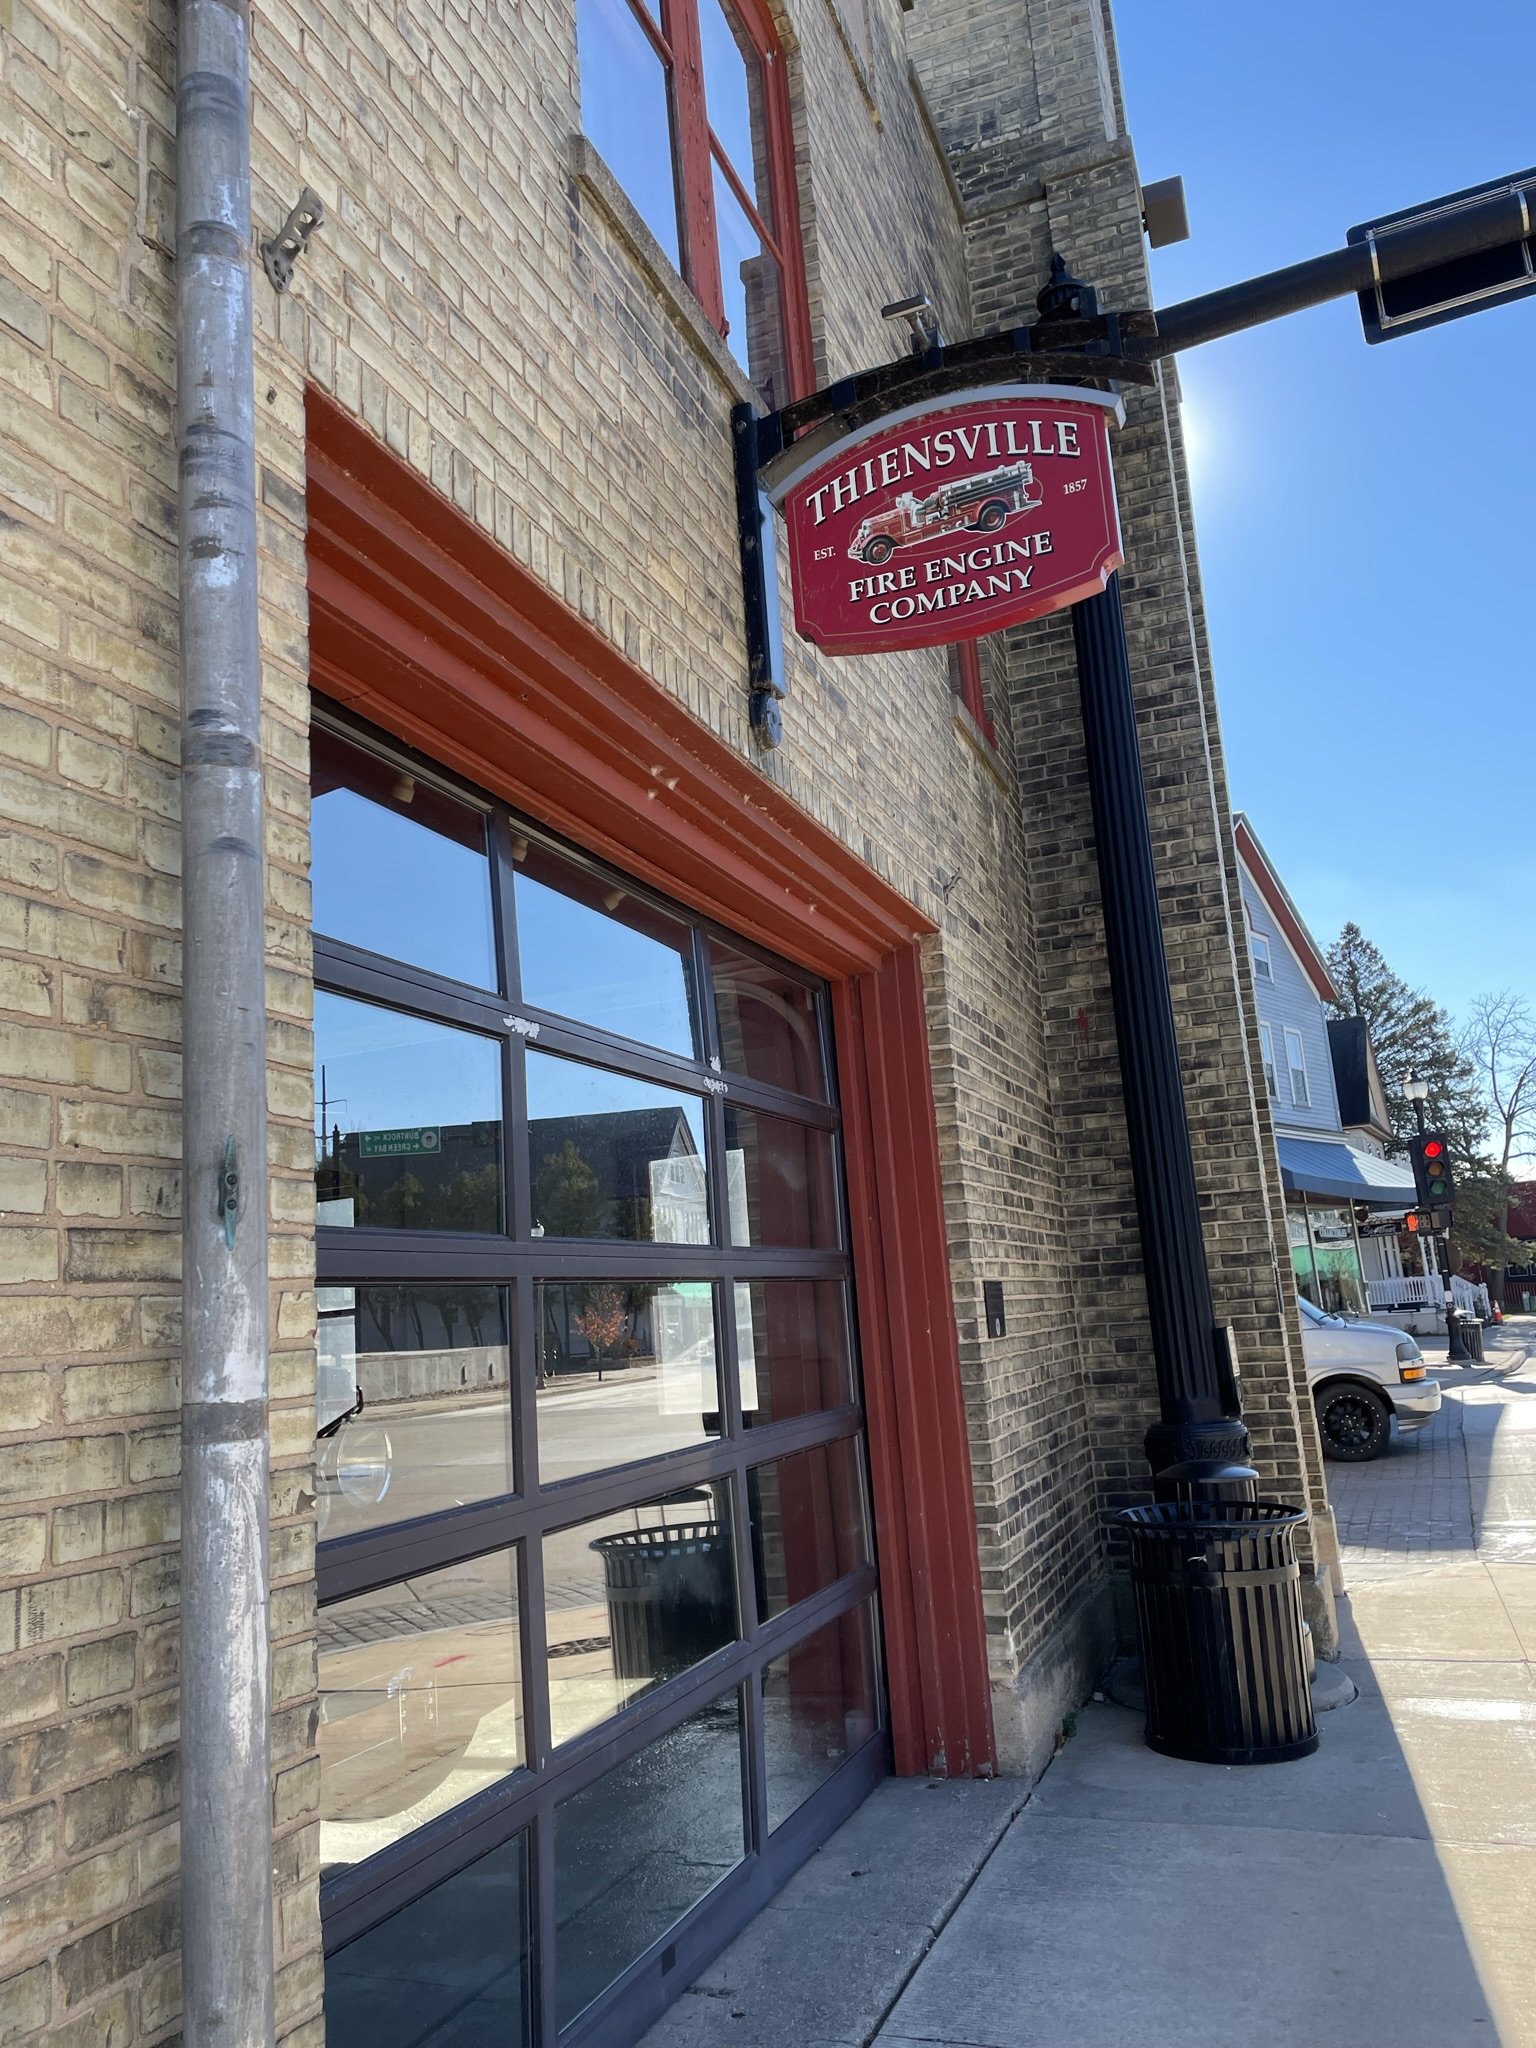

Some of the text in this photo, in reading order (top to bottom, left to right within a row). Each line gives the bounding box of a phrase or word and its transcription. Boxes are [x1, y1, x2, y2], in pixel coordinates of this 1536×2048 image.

[806, 421, 1081, 526] THIENSVILLE
[1063, 478, 1088, 495] 1857
[813, 546, 837, 562] EST.
[848, 531, 1053, 602] FIRE ENGINE
[869, 566, 1034, 624] COMPANY
